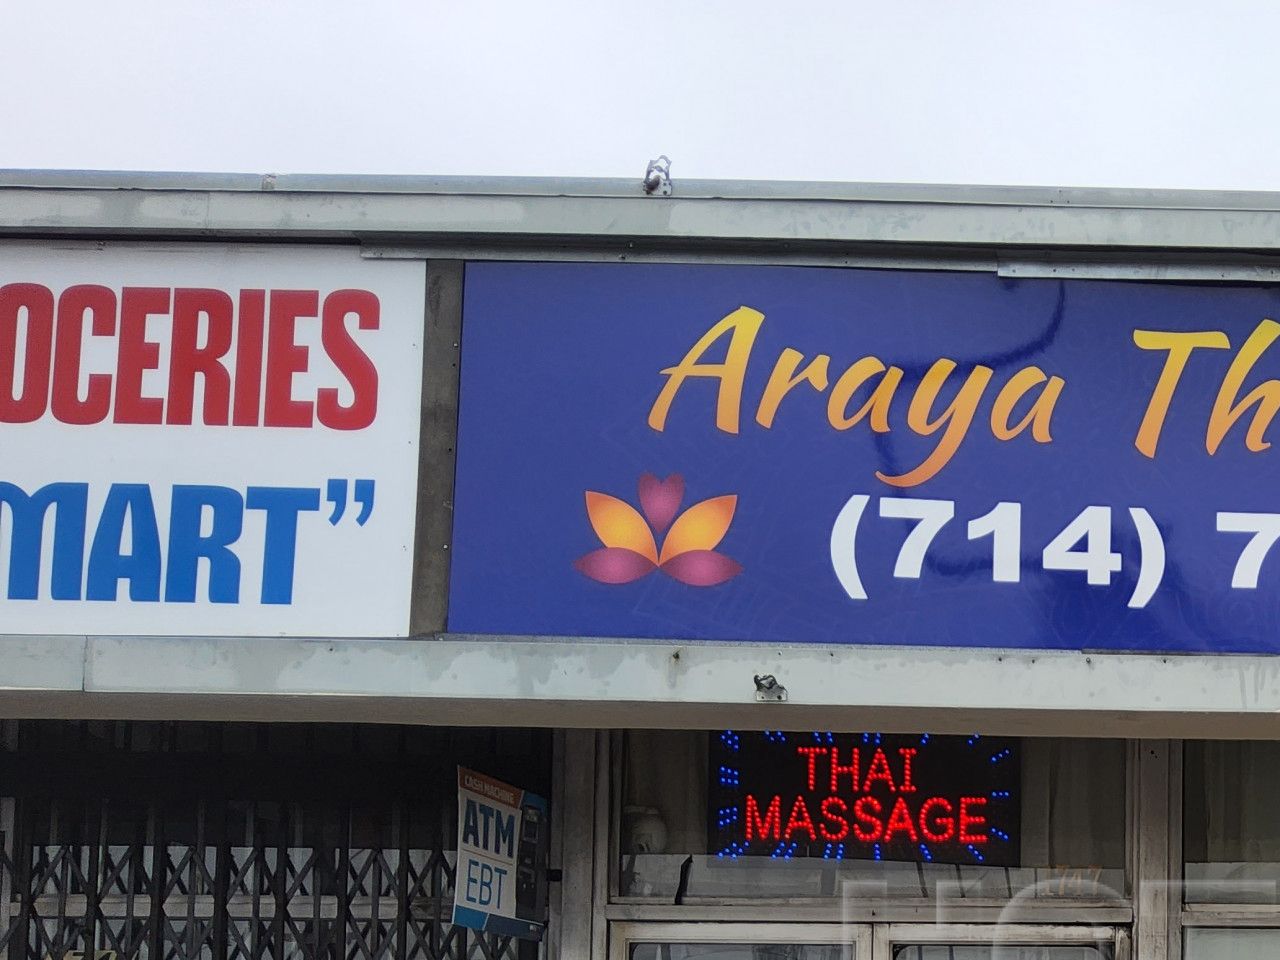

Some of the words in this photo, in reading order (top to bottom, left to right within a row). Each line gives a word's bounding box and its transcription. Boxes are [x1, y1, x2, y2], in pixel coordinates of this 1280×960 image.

[0, 282, 380, 431] OCERIES
[648, 305, 1065, 487] Araya
[830, 494, 1166, 608] (714)
[797, 746, 918, 793] THAI
[462, 797, 516, 859] ATM
[745, 794, 988, 843] MASSAGE
[465, 858, 508, 909] EBT
